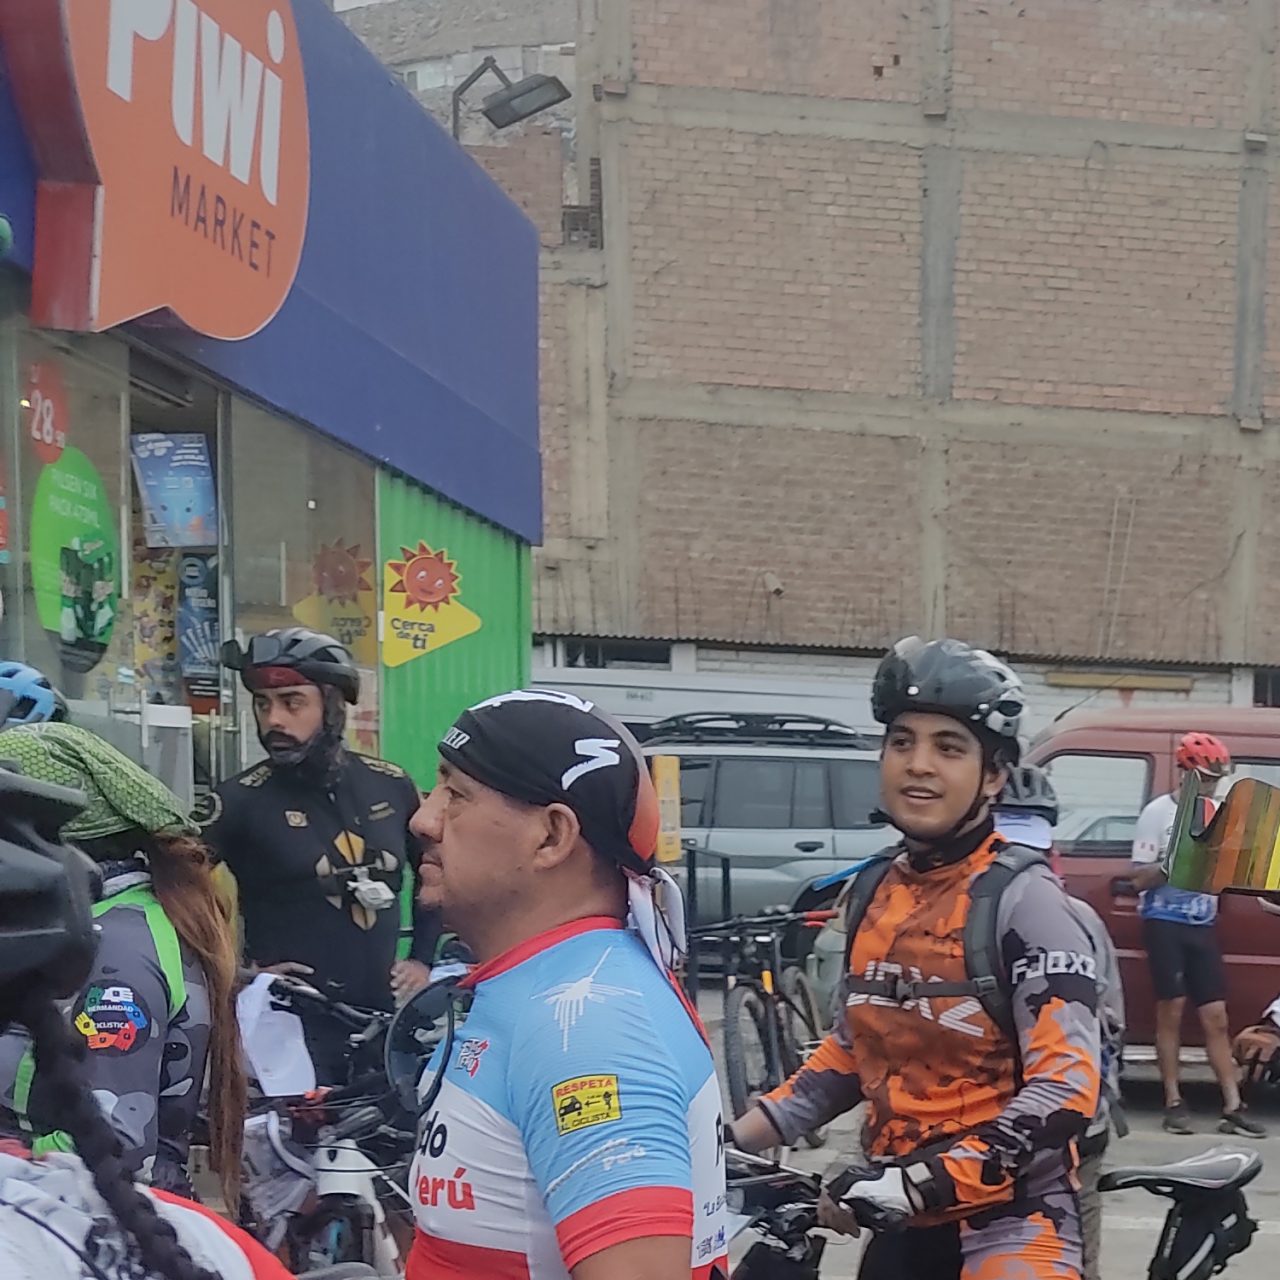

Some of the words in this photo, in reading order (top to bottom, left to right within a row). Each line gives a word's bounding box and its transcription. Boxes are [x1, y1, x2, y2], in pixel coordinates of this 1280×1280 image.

[170, 165, 277, 279] MARKET
[391, 617, 435, 633] Cerca
[412, 634, 429, 649] ti
[87, 1004, 134, 1012] HERMANDAD
[556, 1079, 613, 1098] RESPETA
[572, 1112, 611, 1128] CICLISTA
[415, 1164, 476, 1211] erú
